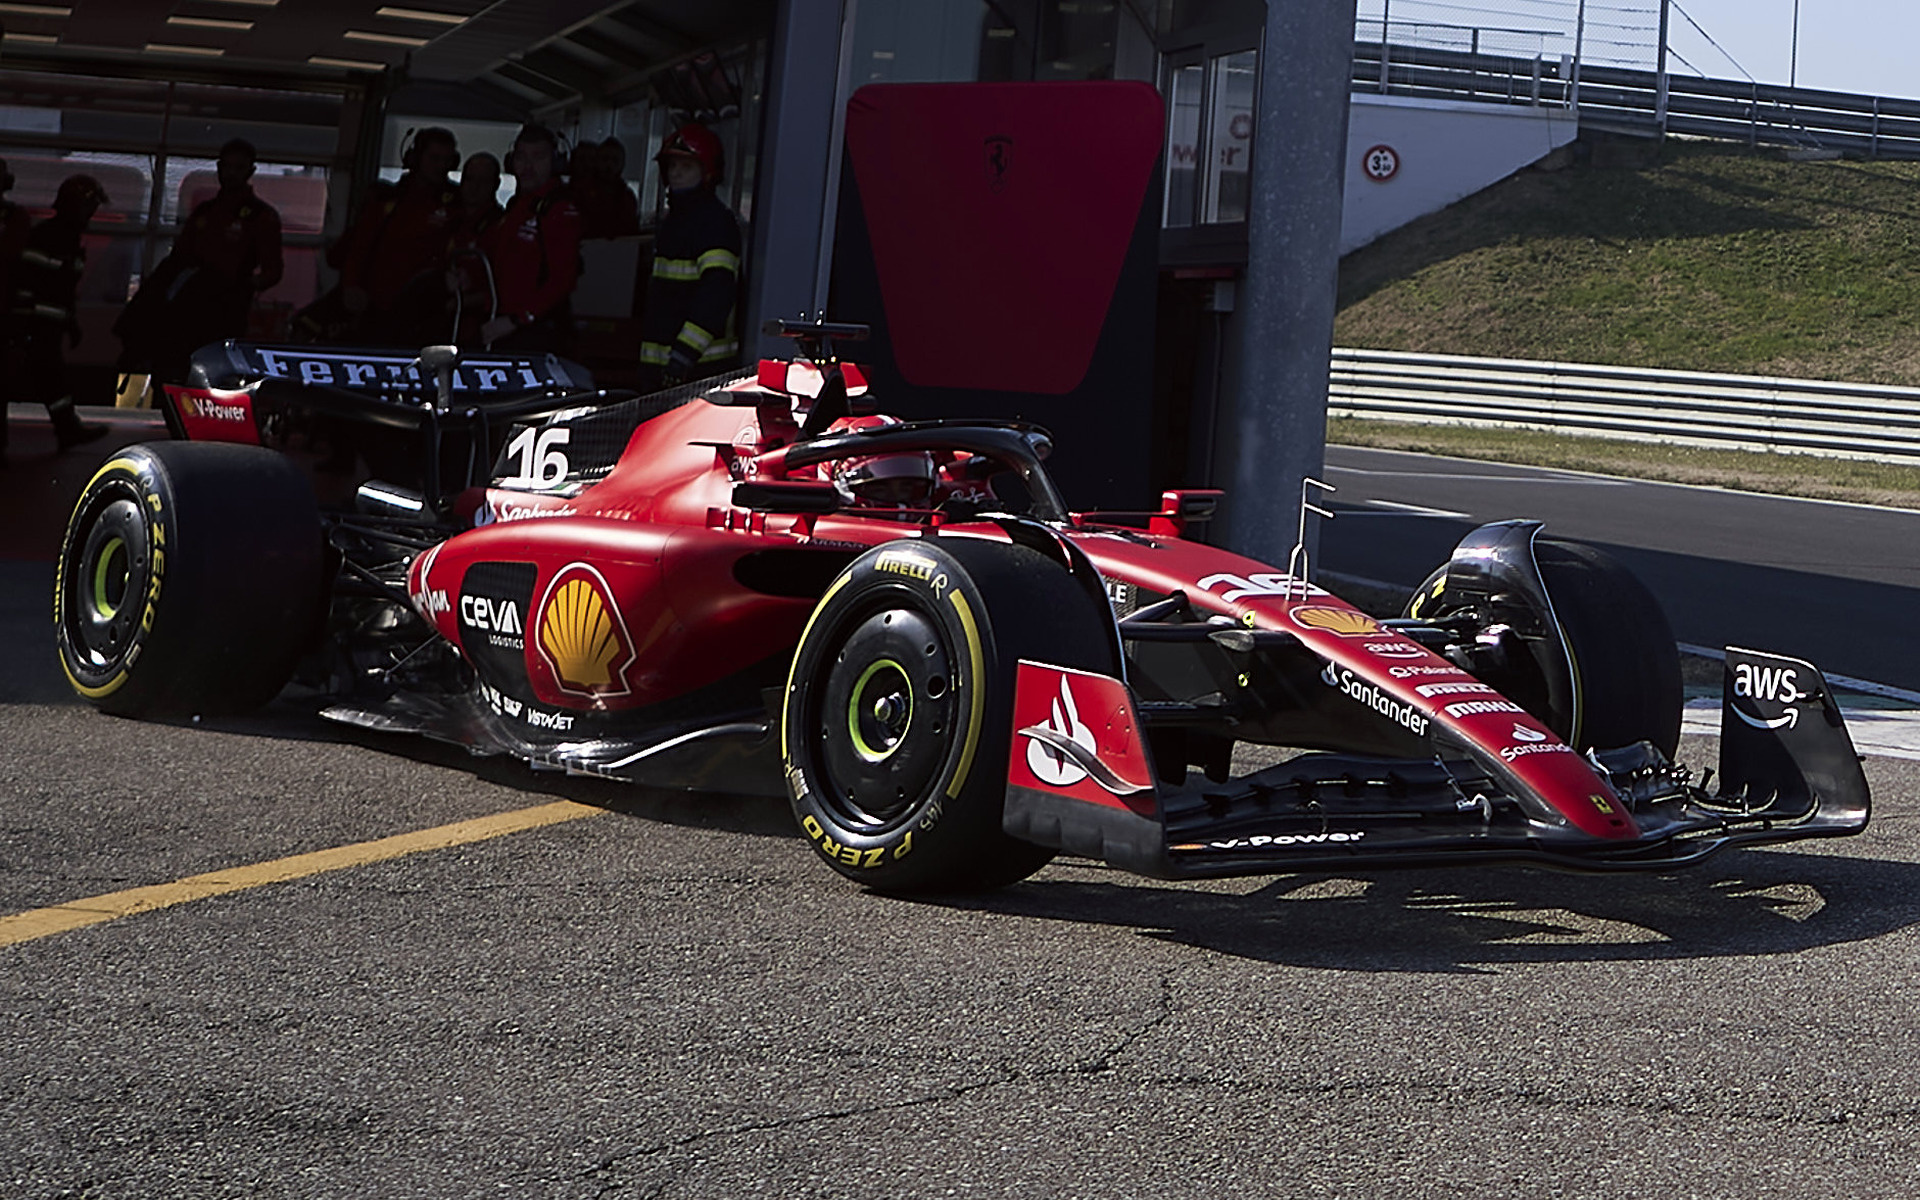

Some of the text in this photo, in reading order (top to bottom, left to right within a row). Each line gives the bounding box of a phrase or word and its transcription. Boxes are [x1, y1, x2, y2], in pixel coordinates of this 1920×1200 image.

[193, 398, 246, 421] V-Power
[499, 427, 570, 490] 16
[142, 522, 165, 633] ZERO
[874, 550, 938, 581] PIRELLI
[488, 634, 524, 650] LOGISTICS
[1415, 682, 1498, 699] PIRELL
[1734, 663, 1798, 704] aws
[1340, 669, 1429, 737] Santander
[1444, 701, 1526, 719] MAHL
[802, 814, 913, 869] P ZERO
[1210, 831, 1366, 849] V-Power
